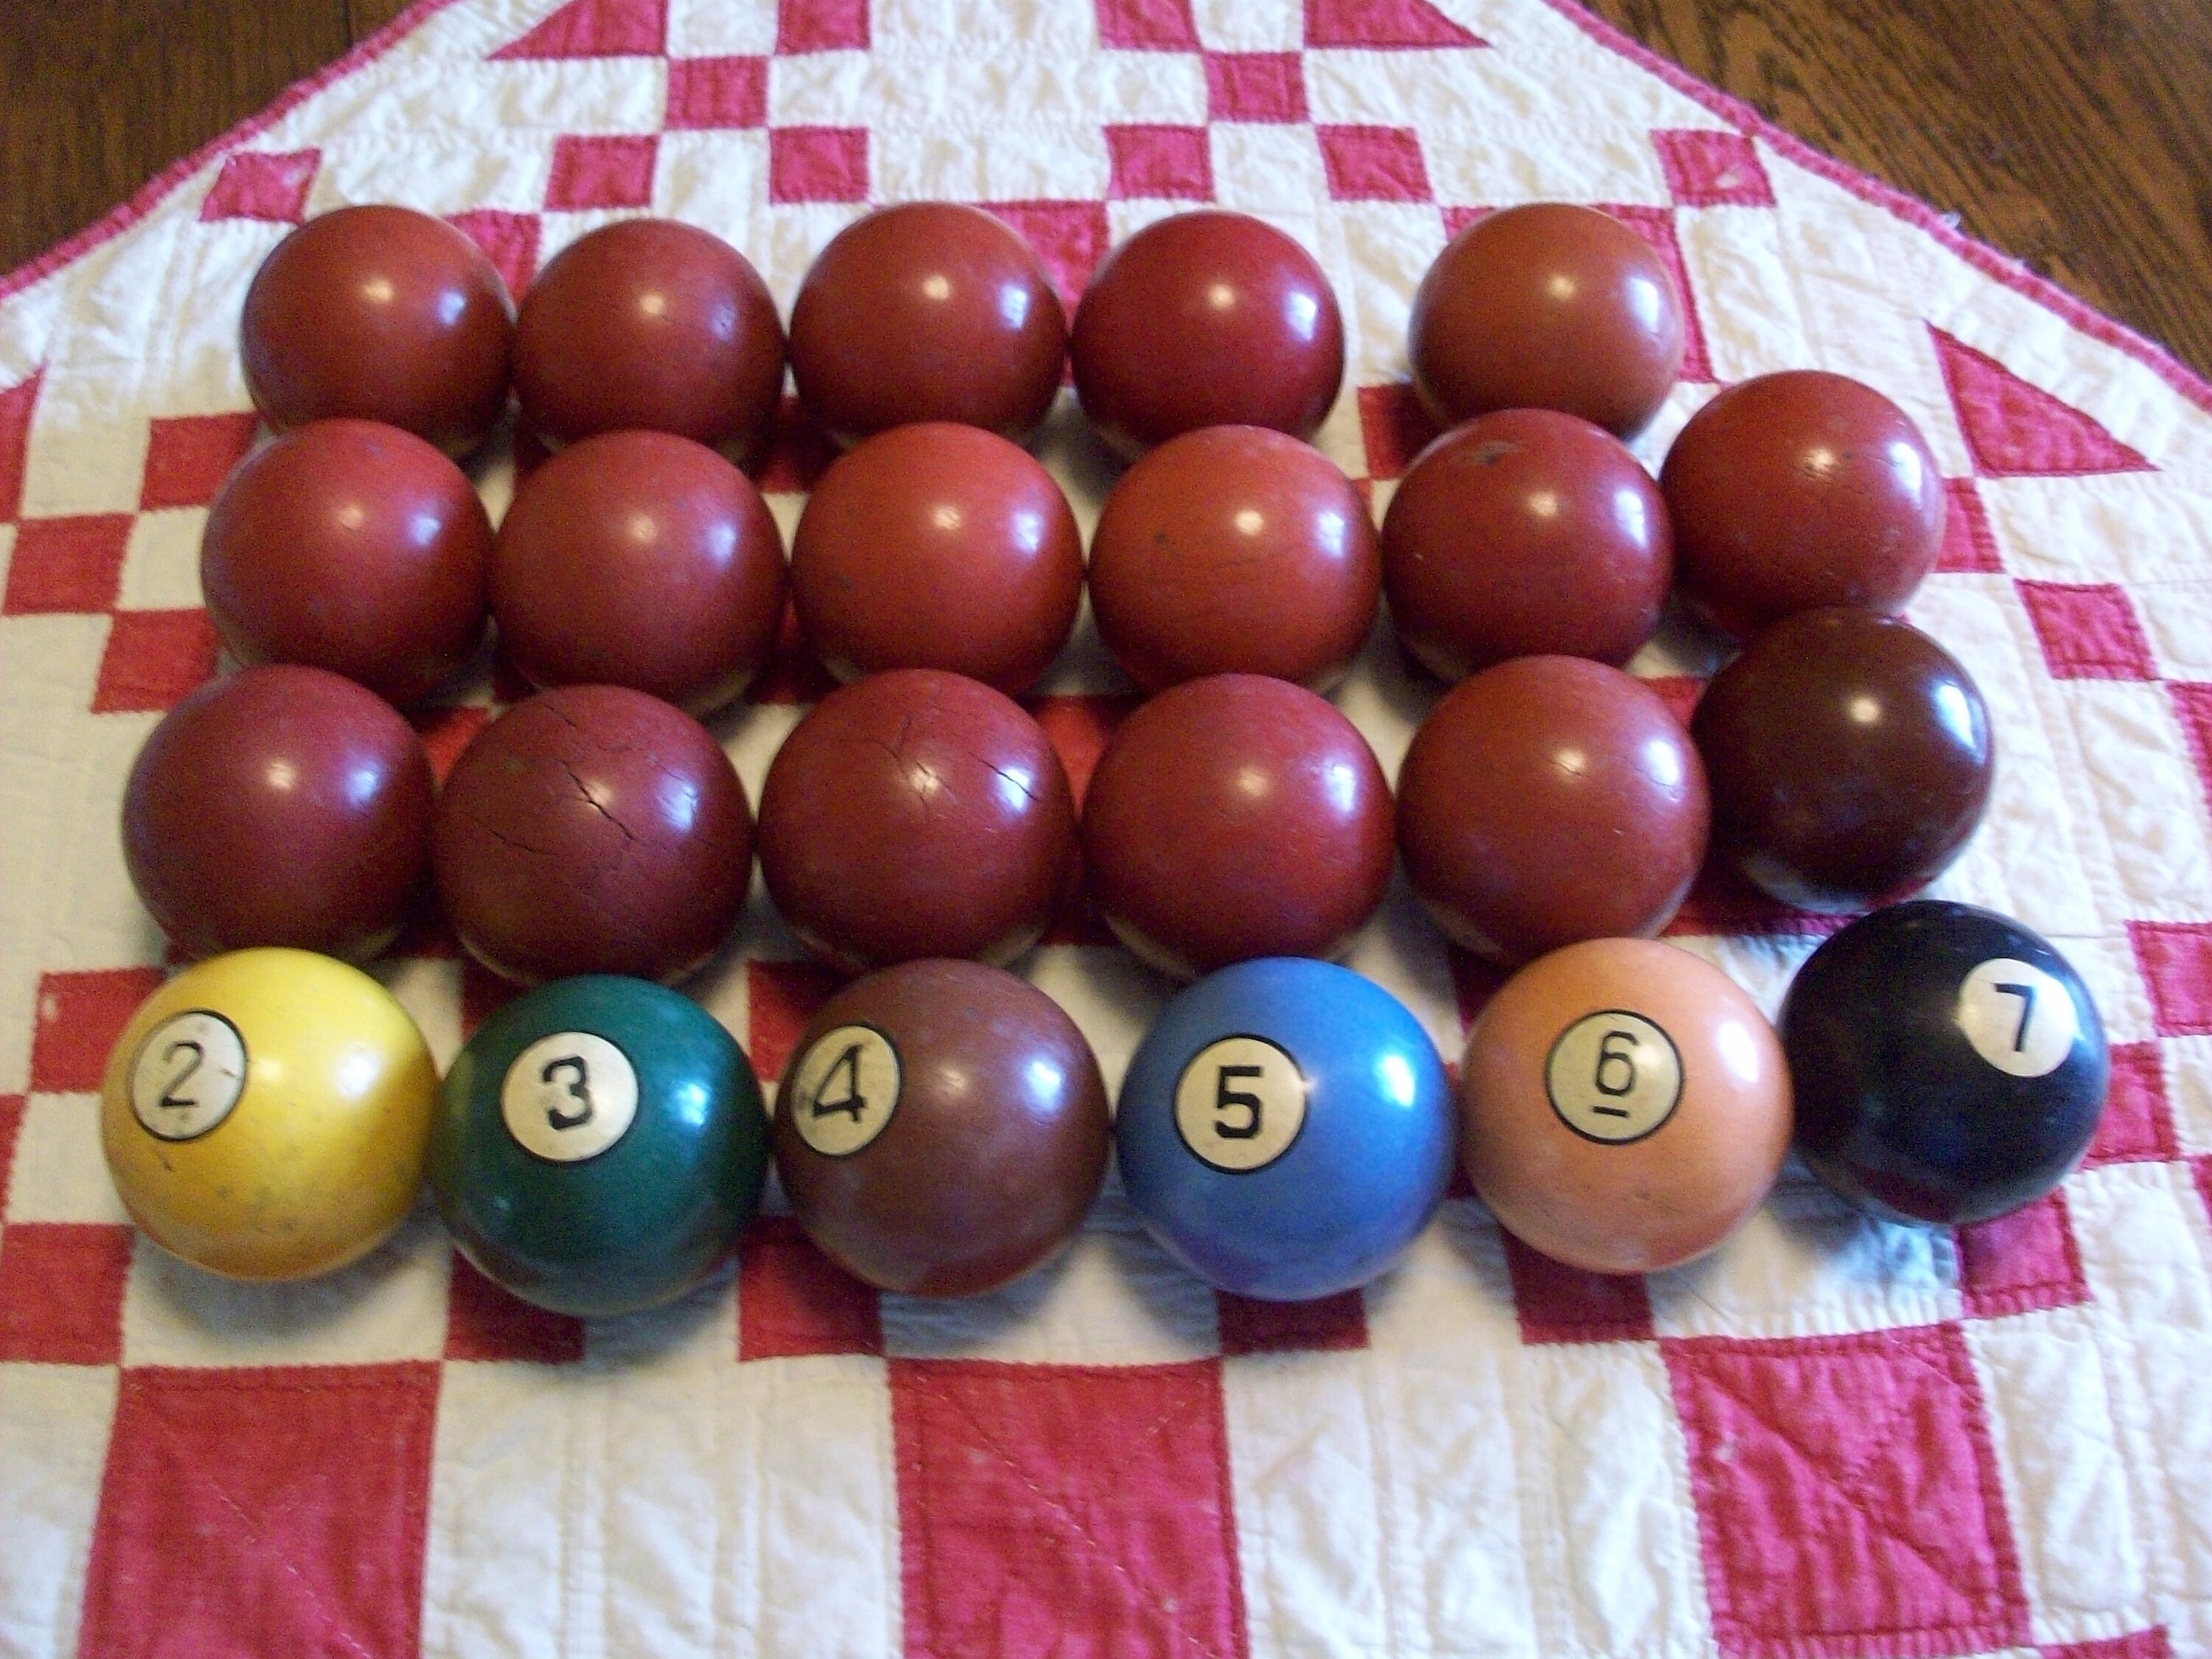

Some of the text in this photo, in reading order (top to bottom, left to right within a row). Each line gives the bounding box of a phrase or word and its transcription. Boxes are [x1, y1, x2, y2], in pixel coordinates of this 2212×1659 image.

[1994, 982, 2036, 1053] 7
[159, 1040, 204, 1107] 2
[540, 1054, 592, 1131] 3
[812, 1042, 869, 1123] 4
[1593, 1030, 1640, 1098] 6
[1214, 1065, 1262, 1140] 5
